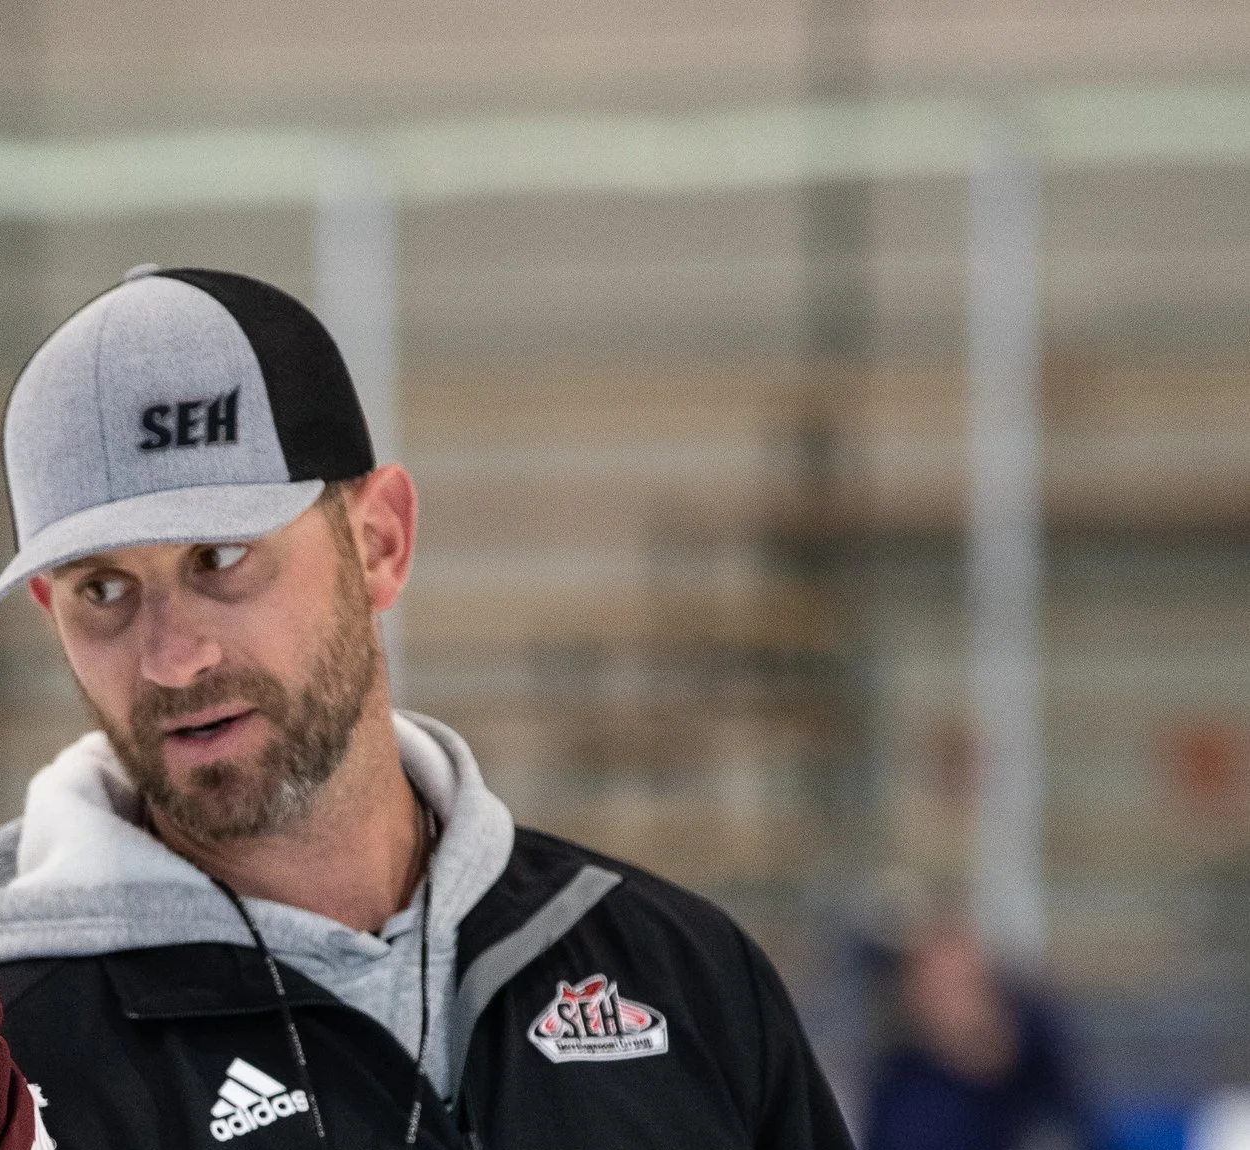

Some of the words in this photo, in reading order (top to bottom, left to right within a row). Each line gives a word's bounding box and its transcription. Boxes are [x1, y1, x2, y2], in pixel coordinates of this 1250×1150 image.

[140, 386, 240, 450] SEH
[557, 991, 623, 1039] SEH
[210, 1089, 310, 1142] adidas
